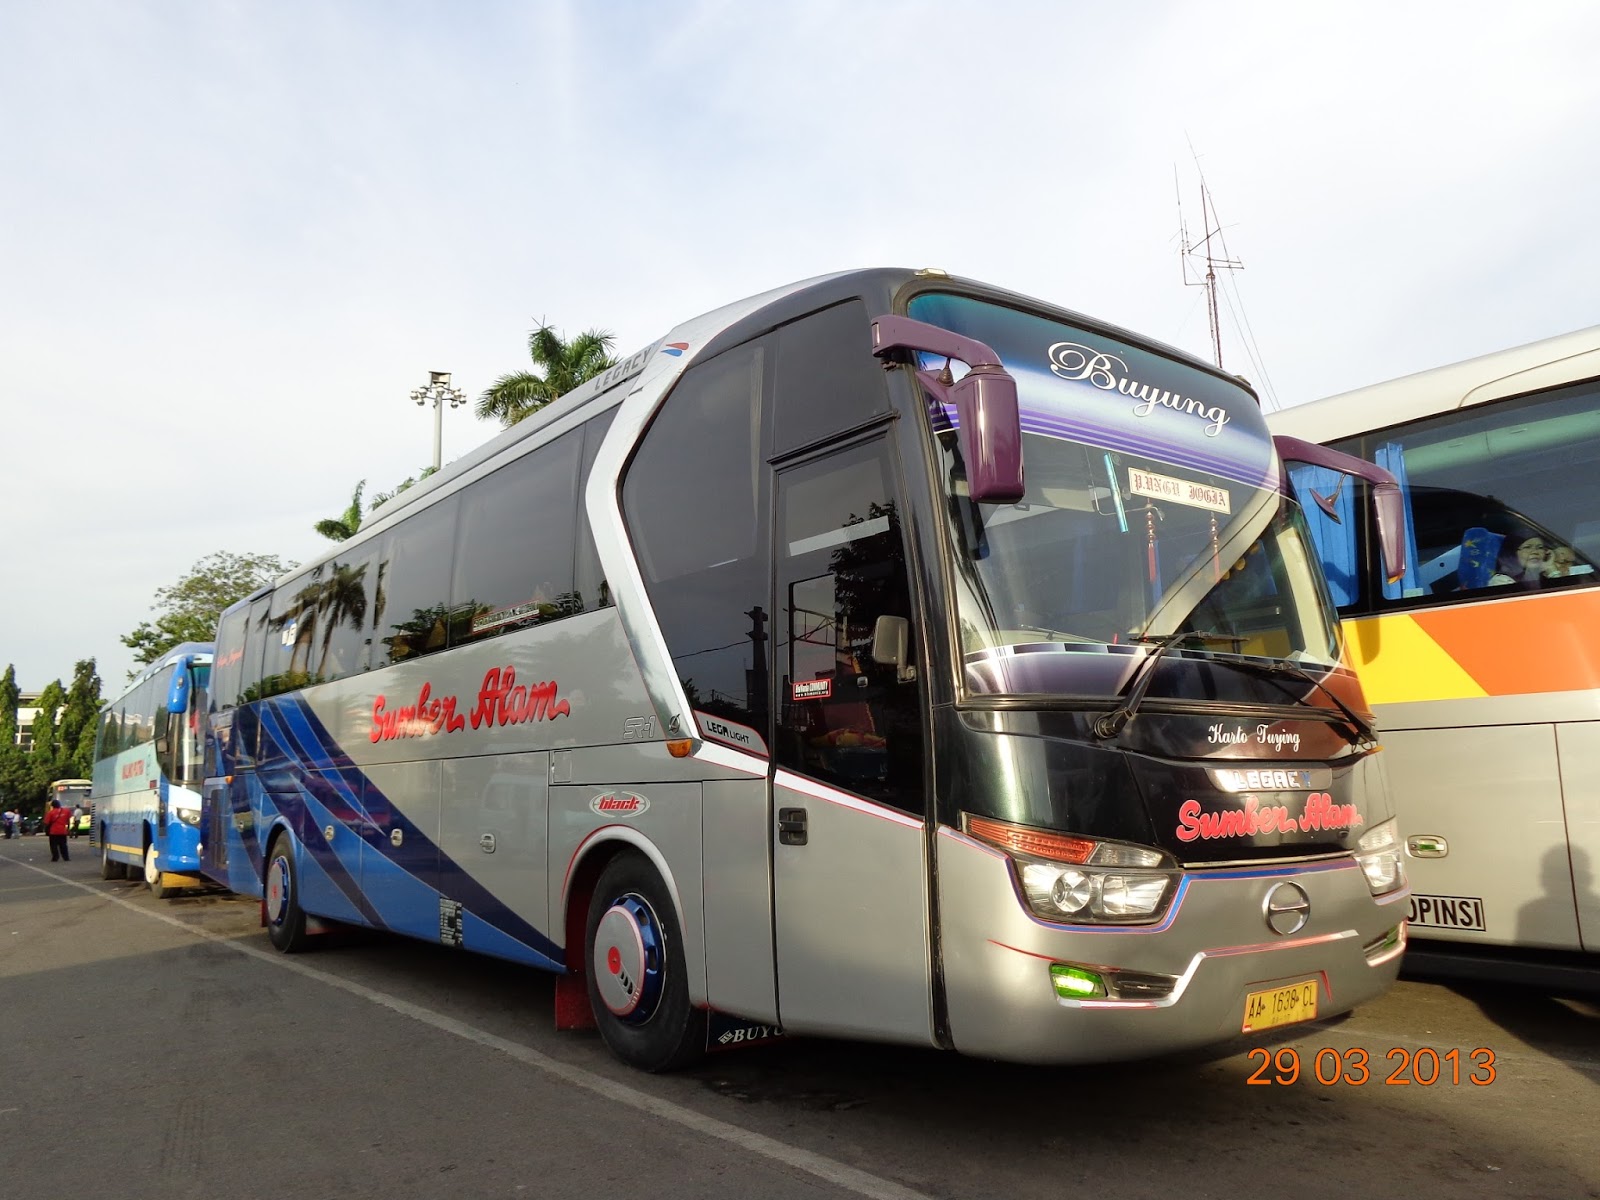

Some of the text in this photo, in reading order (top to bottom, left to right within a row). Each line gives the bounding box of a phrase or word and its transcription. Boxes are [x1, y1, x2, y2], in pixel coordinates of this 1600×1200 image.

[595, 347, 651, 391] LEGACY
[1048, 342, 1231, 437] Buyung
[369, 665, 570, 743] Sumber Alam
[706, 720, 749, 744] LEGA LIGHT
[1256, 724, 1300, 752] Tuying
[599, 795, 640, 810] black
[1176, 792, 1363, 842] Sumber Alam
[1248, 996, 1262, 1019] AA
[1272, 989, 1297, 1014] 1638
